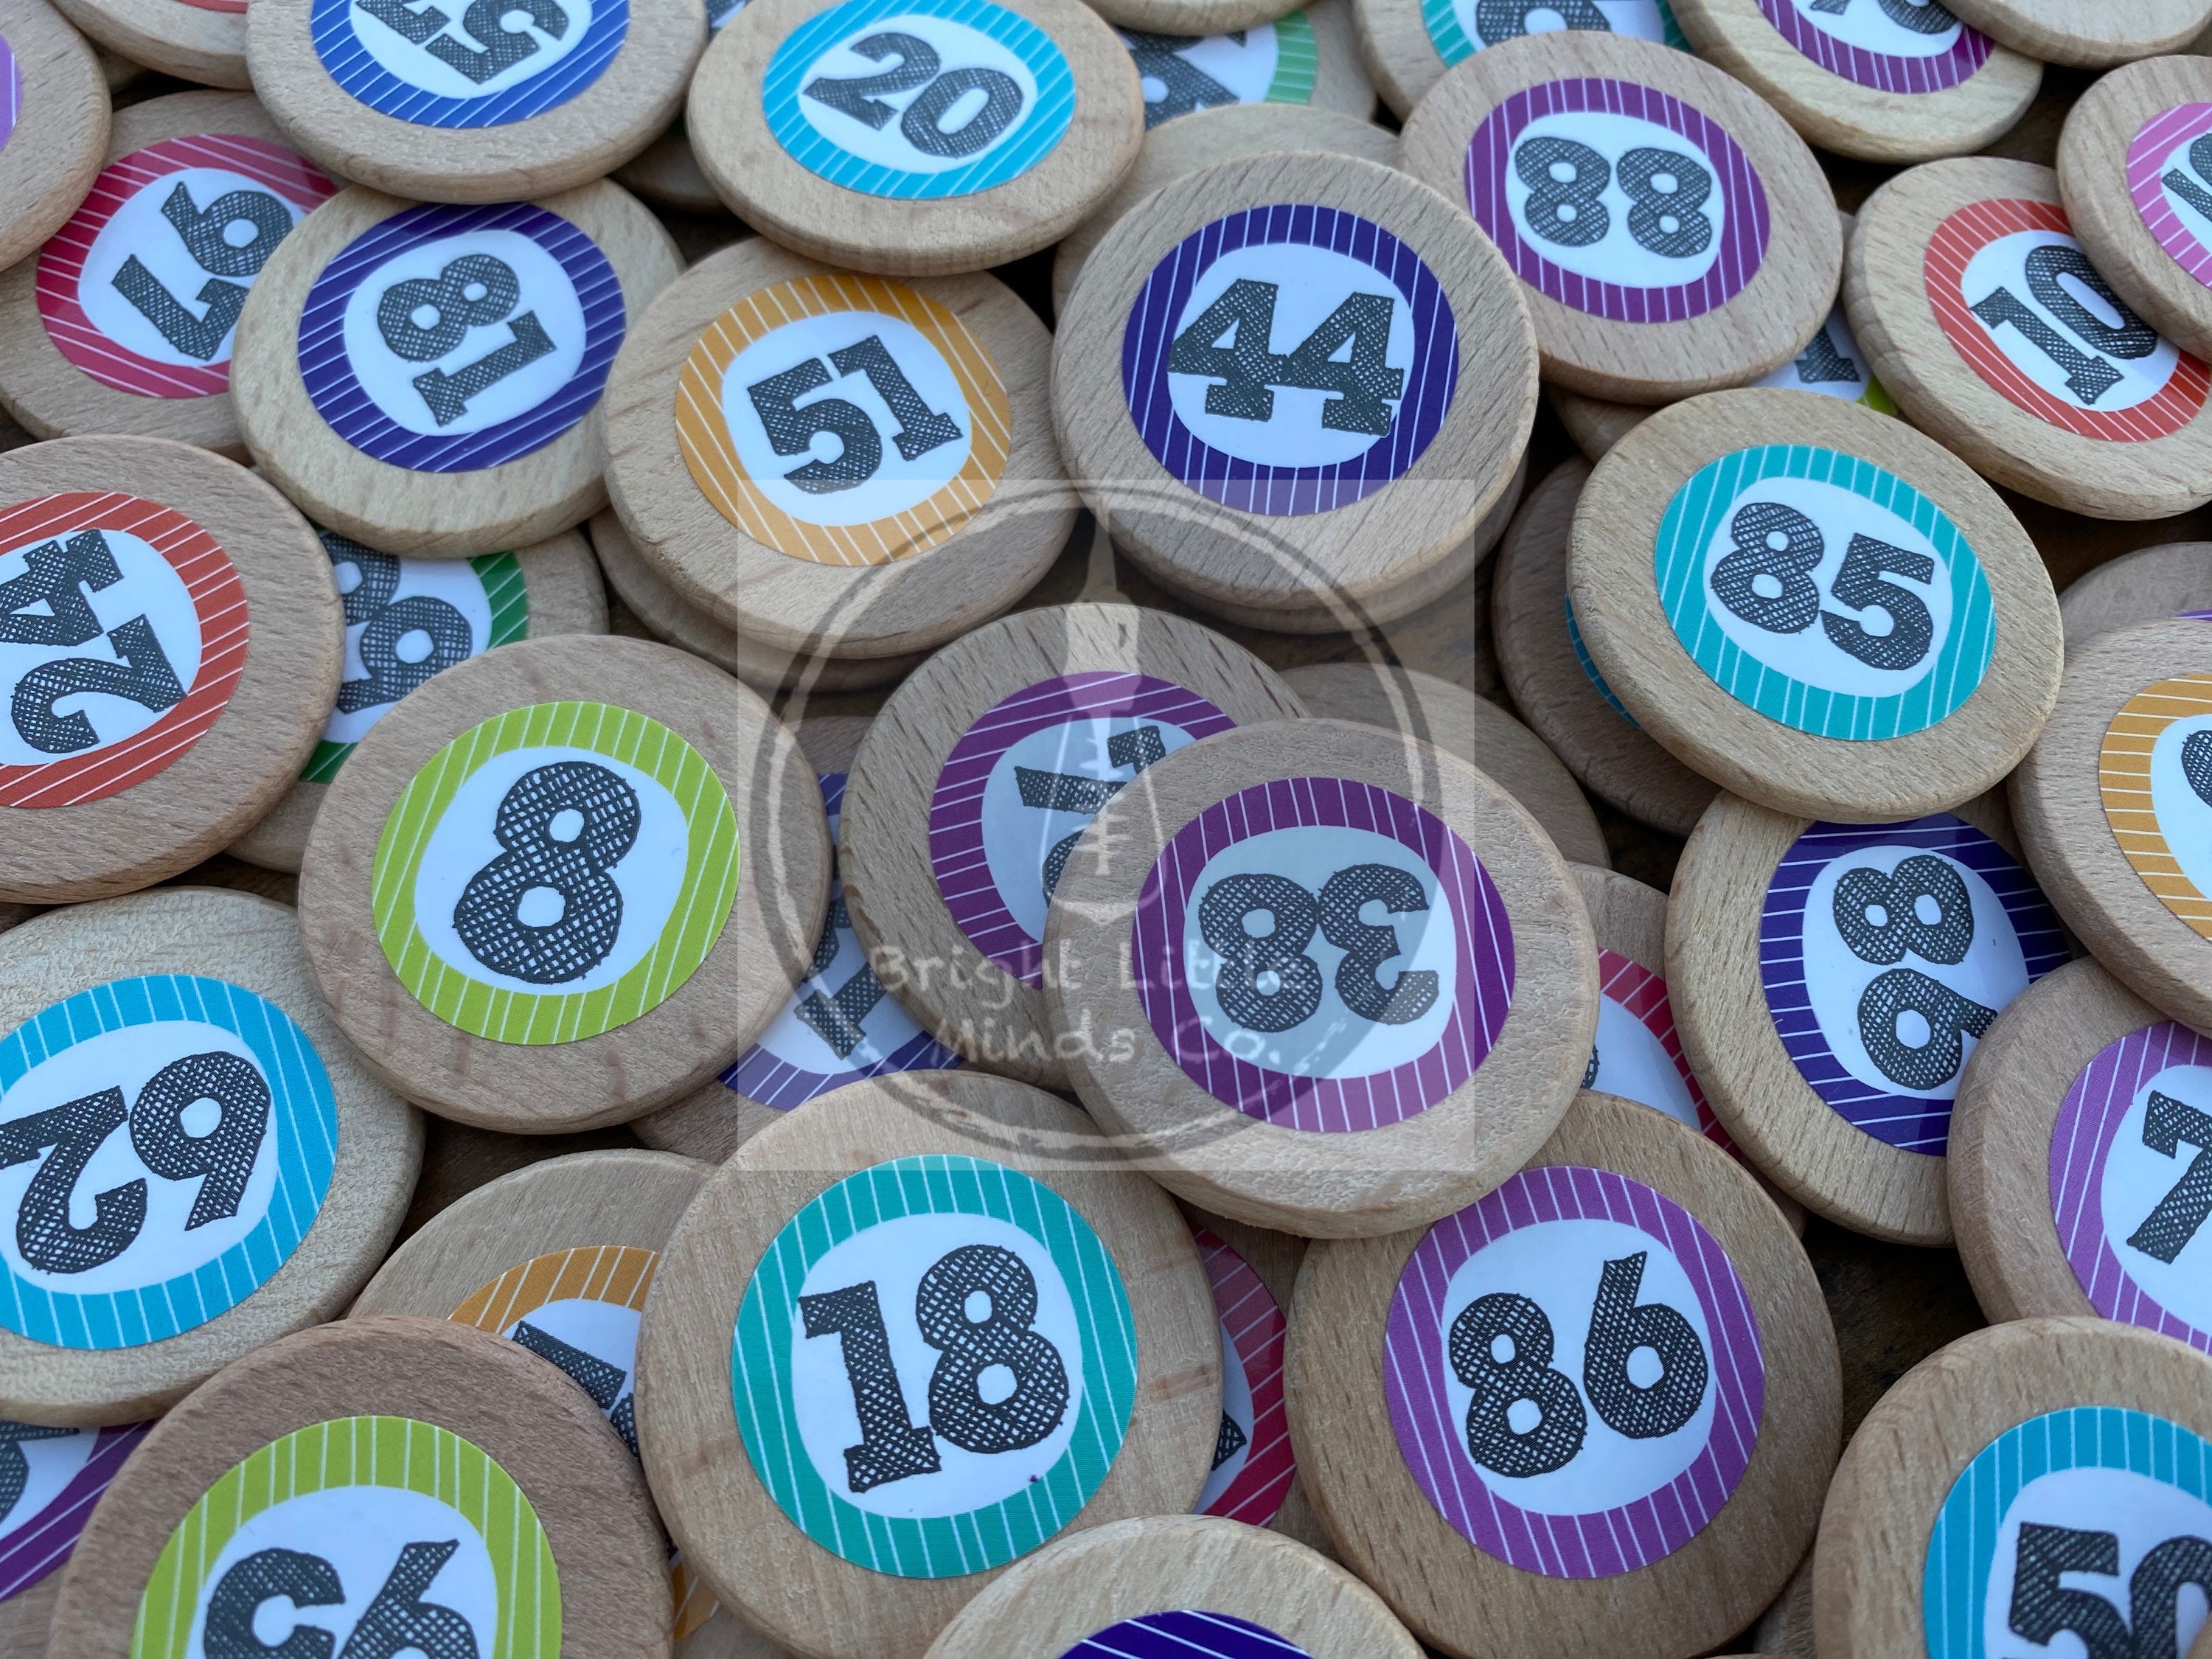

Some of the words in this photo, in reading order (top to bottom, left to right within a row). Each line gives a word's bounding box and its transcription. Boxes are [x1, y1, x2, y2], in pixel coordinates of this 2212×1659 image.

[802, 32, 1024, 159] 20
[1514, 136, 1711, 258] 88
[377, 253, 557, 428] 81
[1167, 278, 1404, 437] 44
[1971, 245, 2159, 405] 10
[747, 334, 963, 494] 51
[1710, 502, 1935, 671] 85
[453, 760, 641, 984] 8
[1198, 863, 1439, 1033] 38
[799, 1244, 1069, 1494] 18
[1448, 1251, 1708, 1478] 86
